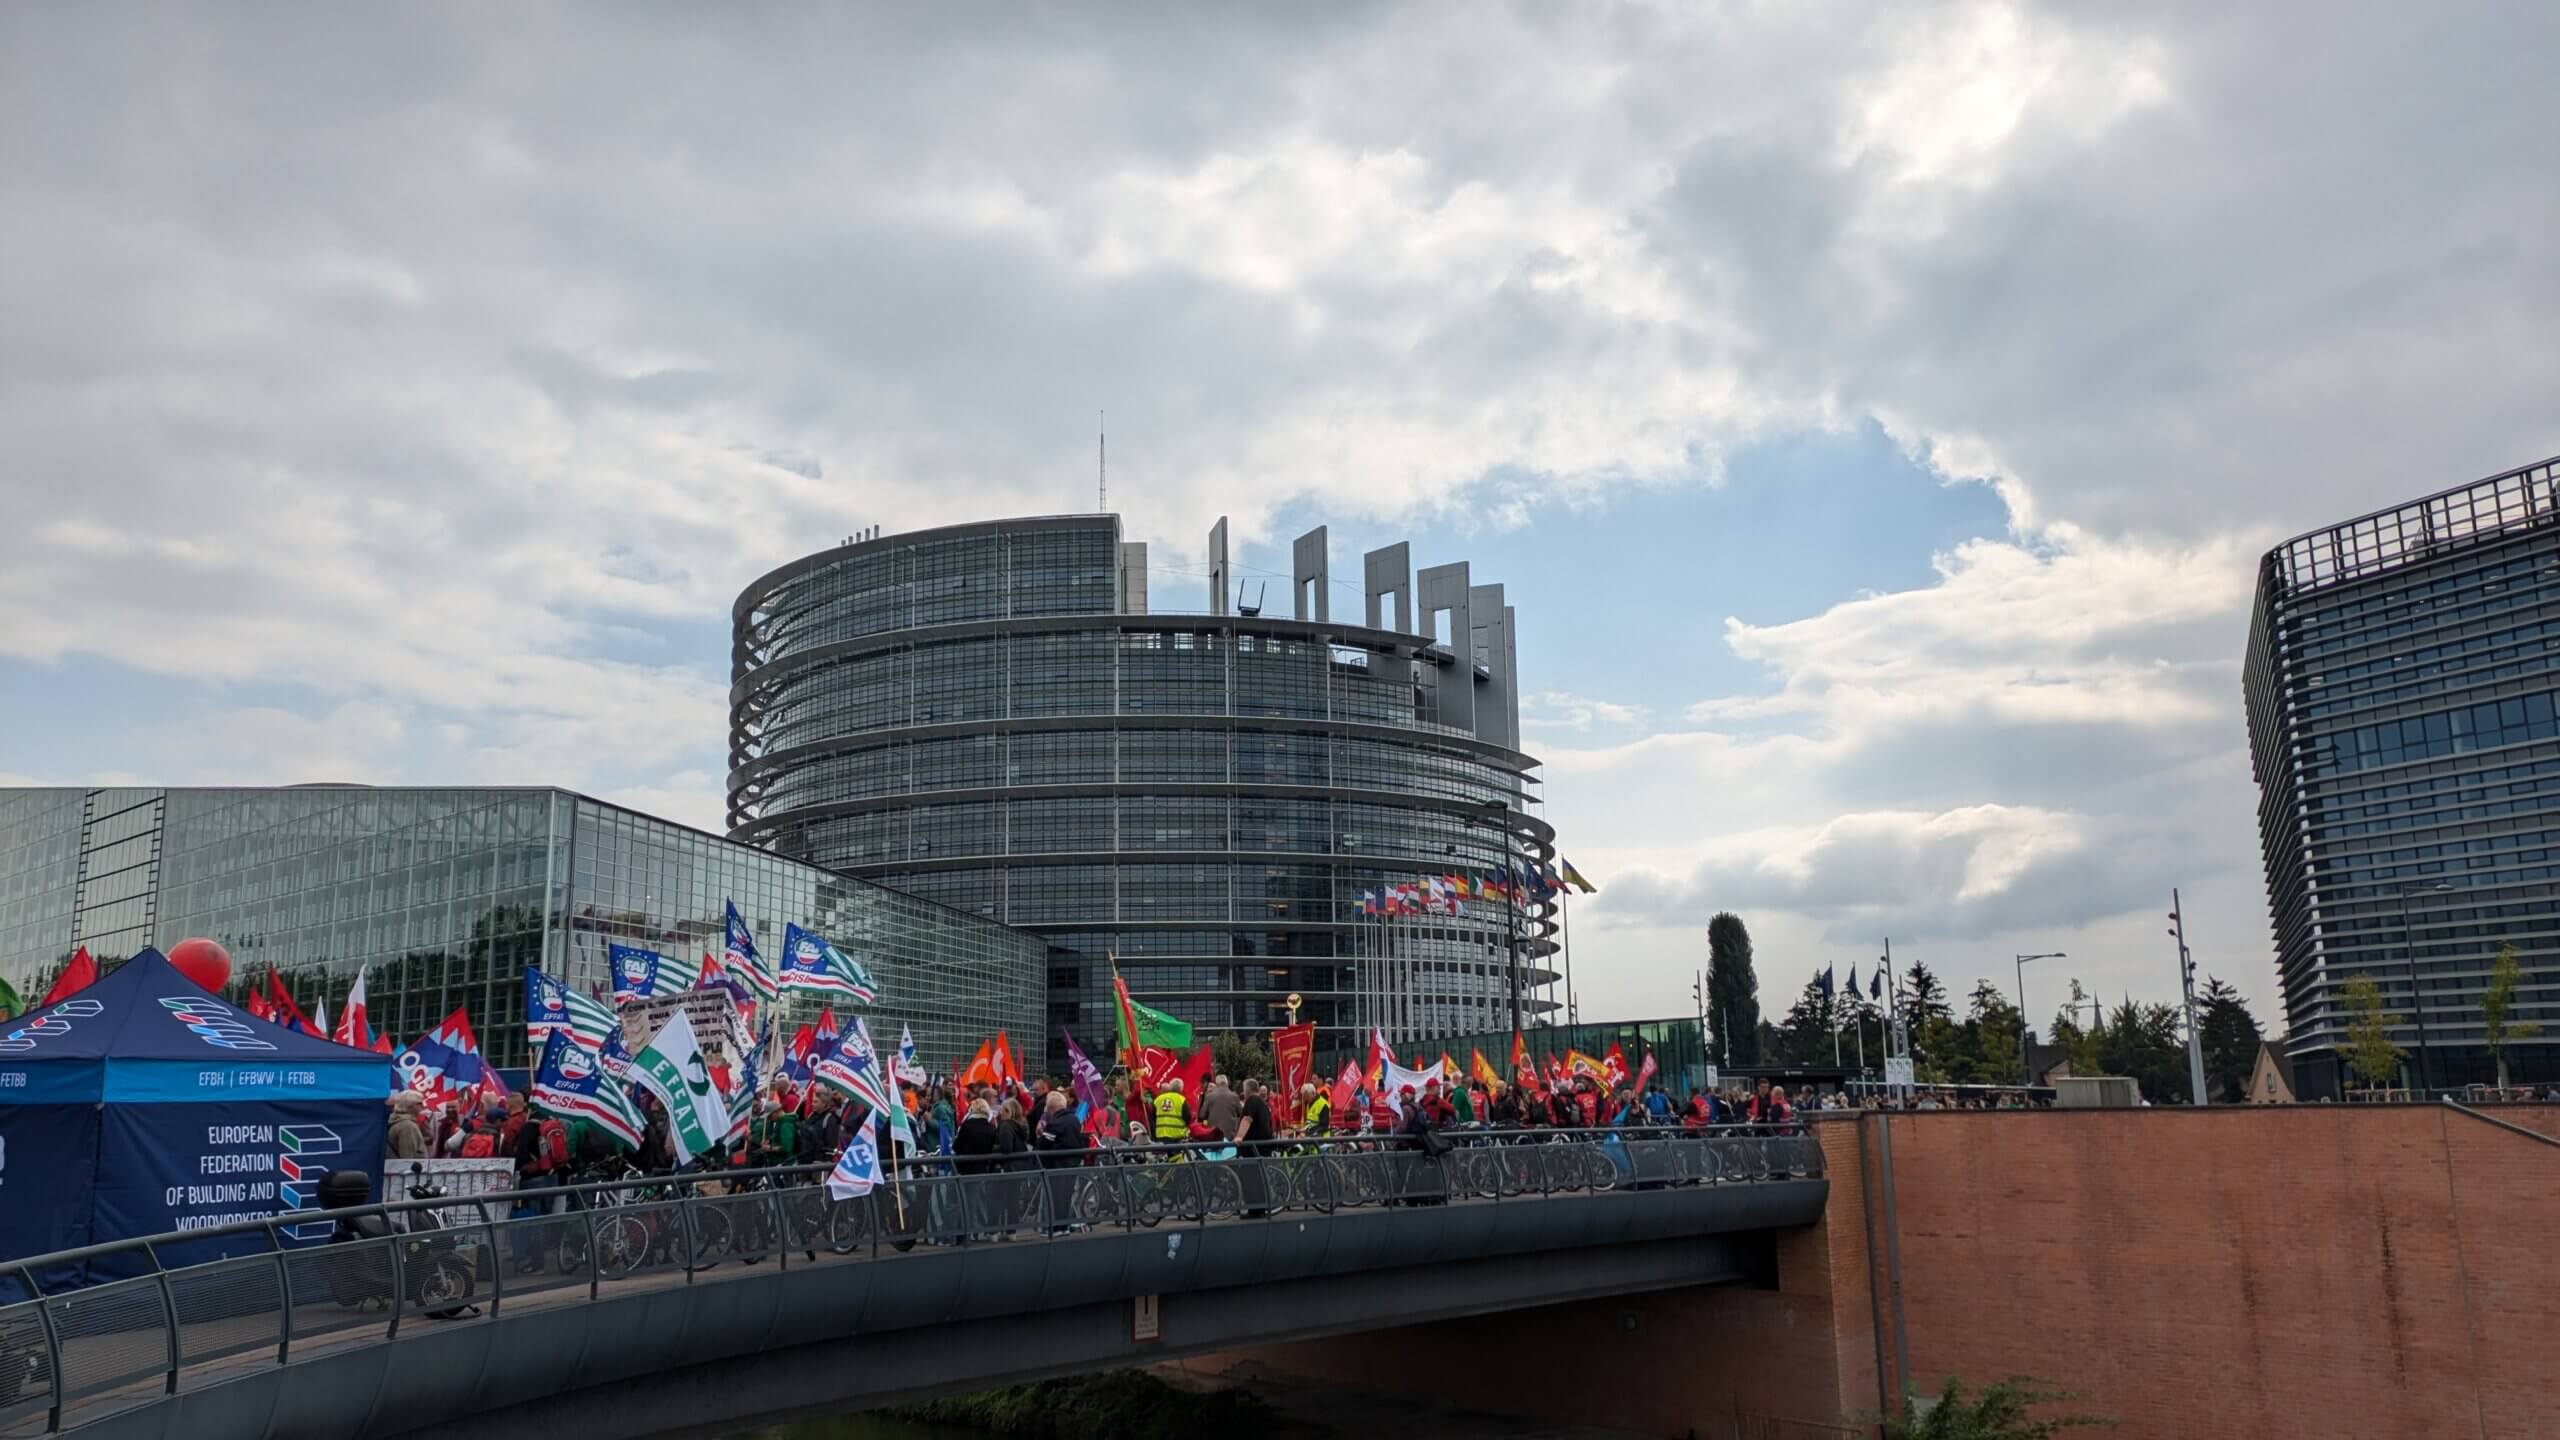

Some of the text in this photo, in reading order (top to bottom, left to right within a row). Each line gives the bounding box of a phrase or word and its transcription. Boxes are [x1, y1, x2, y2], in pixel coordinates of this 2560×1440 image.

[624, 959, 646, 974] FAI
[788, 972, 810, 983] CISL
[563, 1049, 590, 1069] FAI
[199, 1071, 316, 1087] EFBH EFBWW FETBB
[547, 1094, 577, 1110] CISL
[208, 1125, 273, 1145] EUROPEAN
[200, 1153, 274, 1175] FEDERATION
[166, 1181, 275, 1206] OF BUILDING AND
